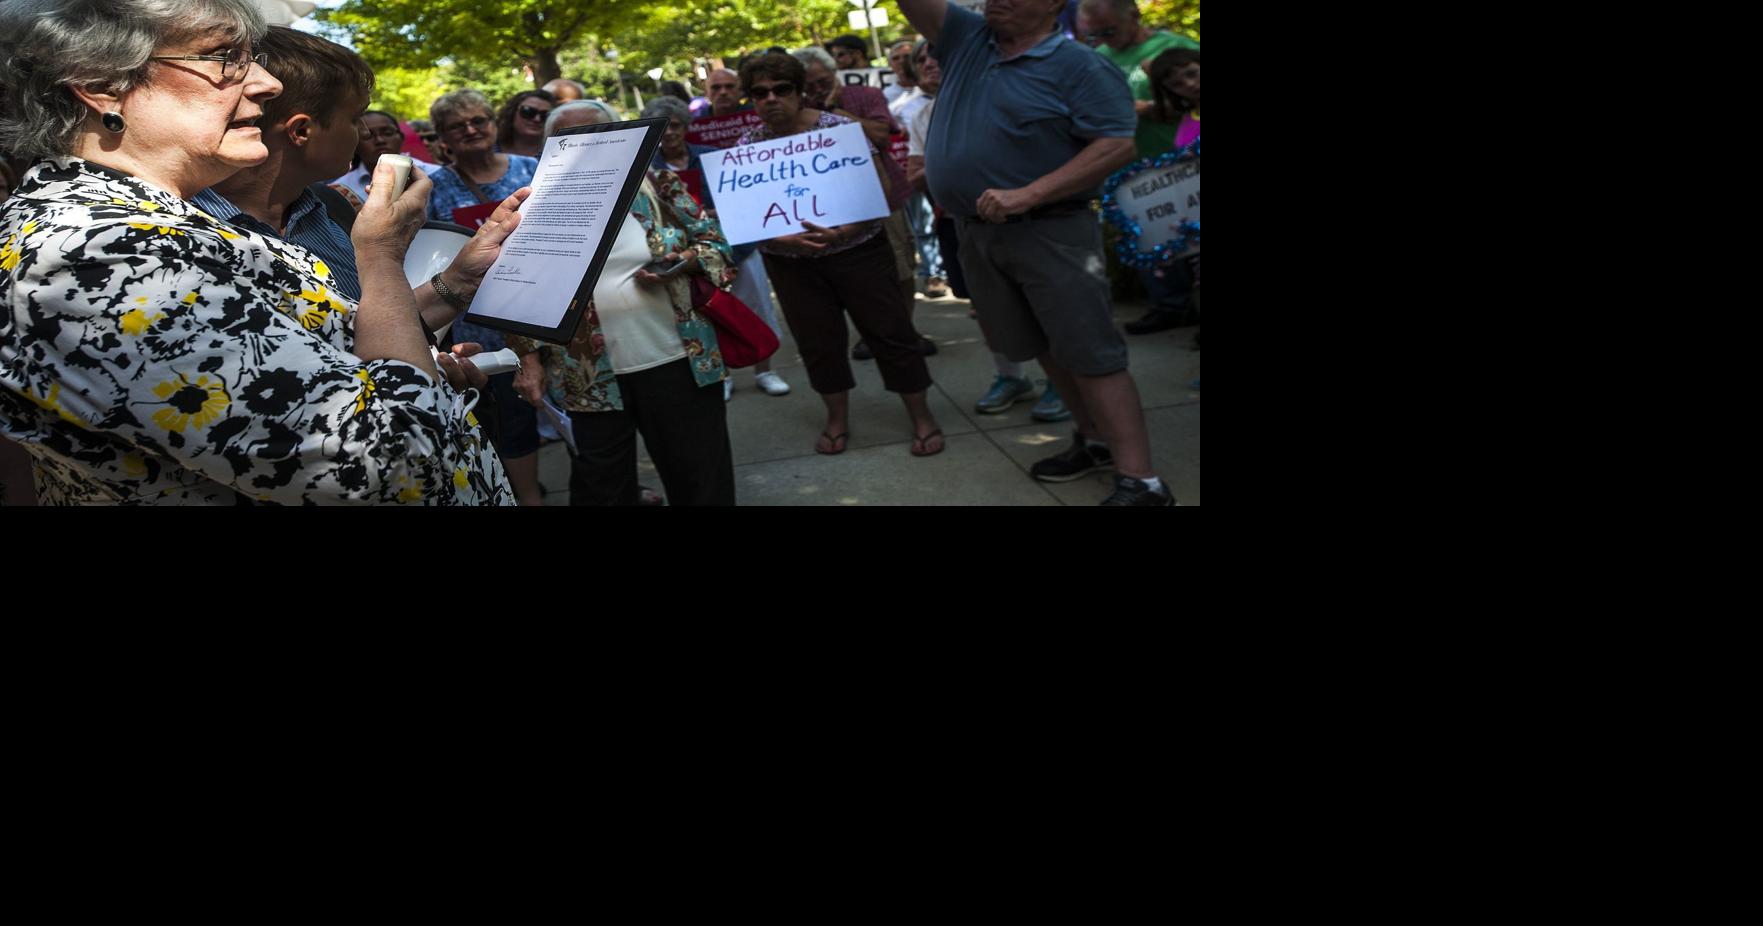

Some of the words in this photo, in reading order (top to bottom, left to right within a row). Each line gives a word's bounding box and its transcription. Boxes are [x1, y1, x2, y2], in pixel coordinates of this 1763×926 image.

[687, 115, 743, 132] Medicaid
[722, 133, 837, 166] Affordable
[717, 160, 808, 193] Health
[812, 153, 869, 173] Care
[784, 183, 810, 198] for
[763, 195, 827, 228] ALL
[1146, 202, 1177, 222] FOR
